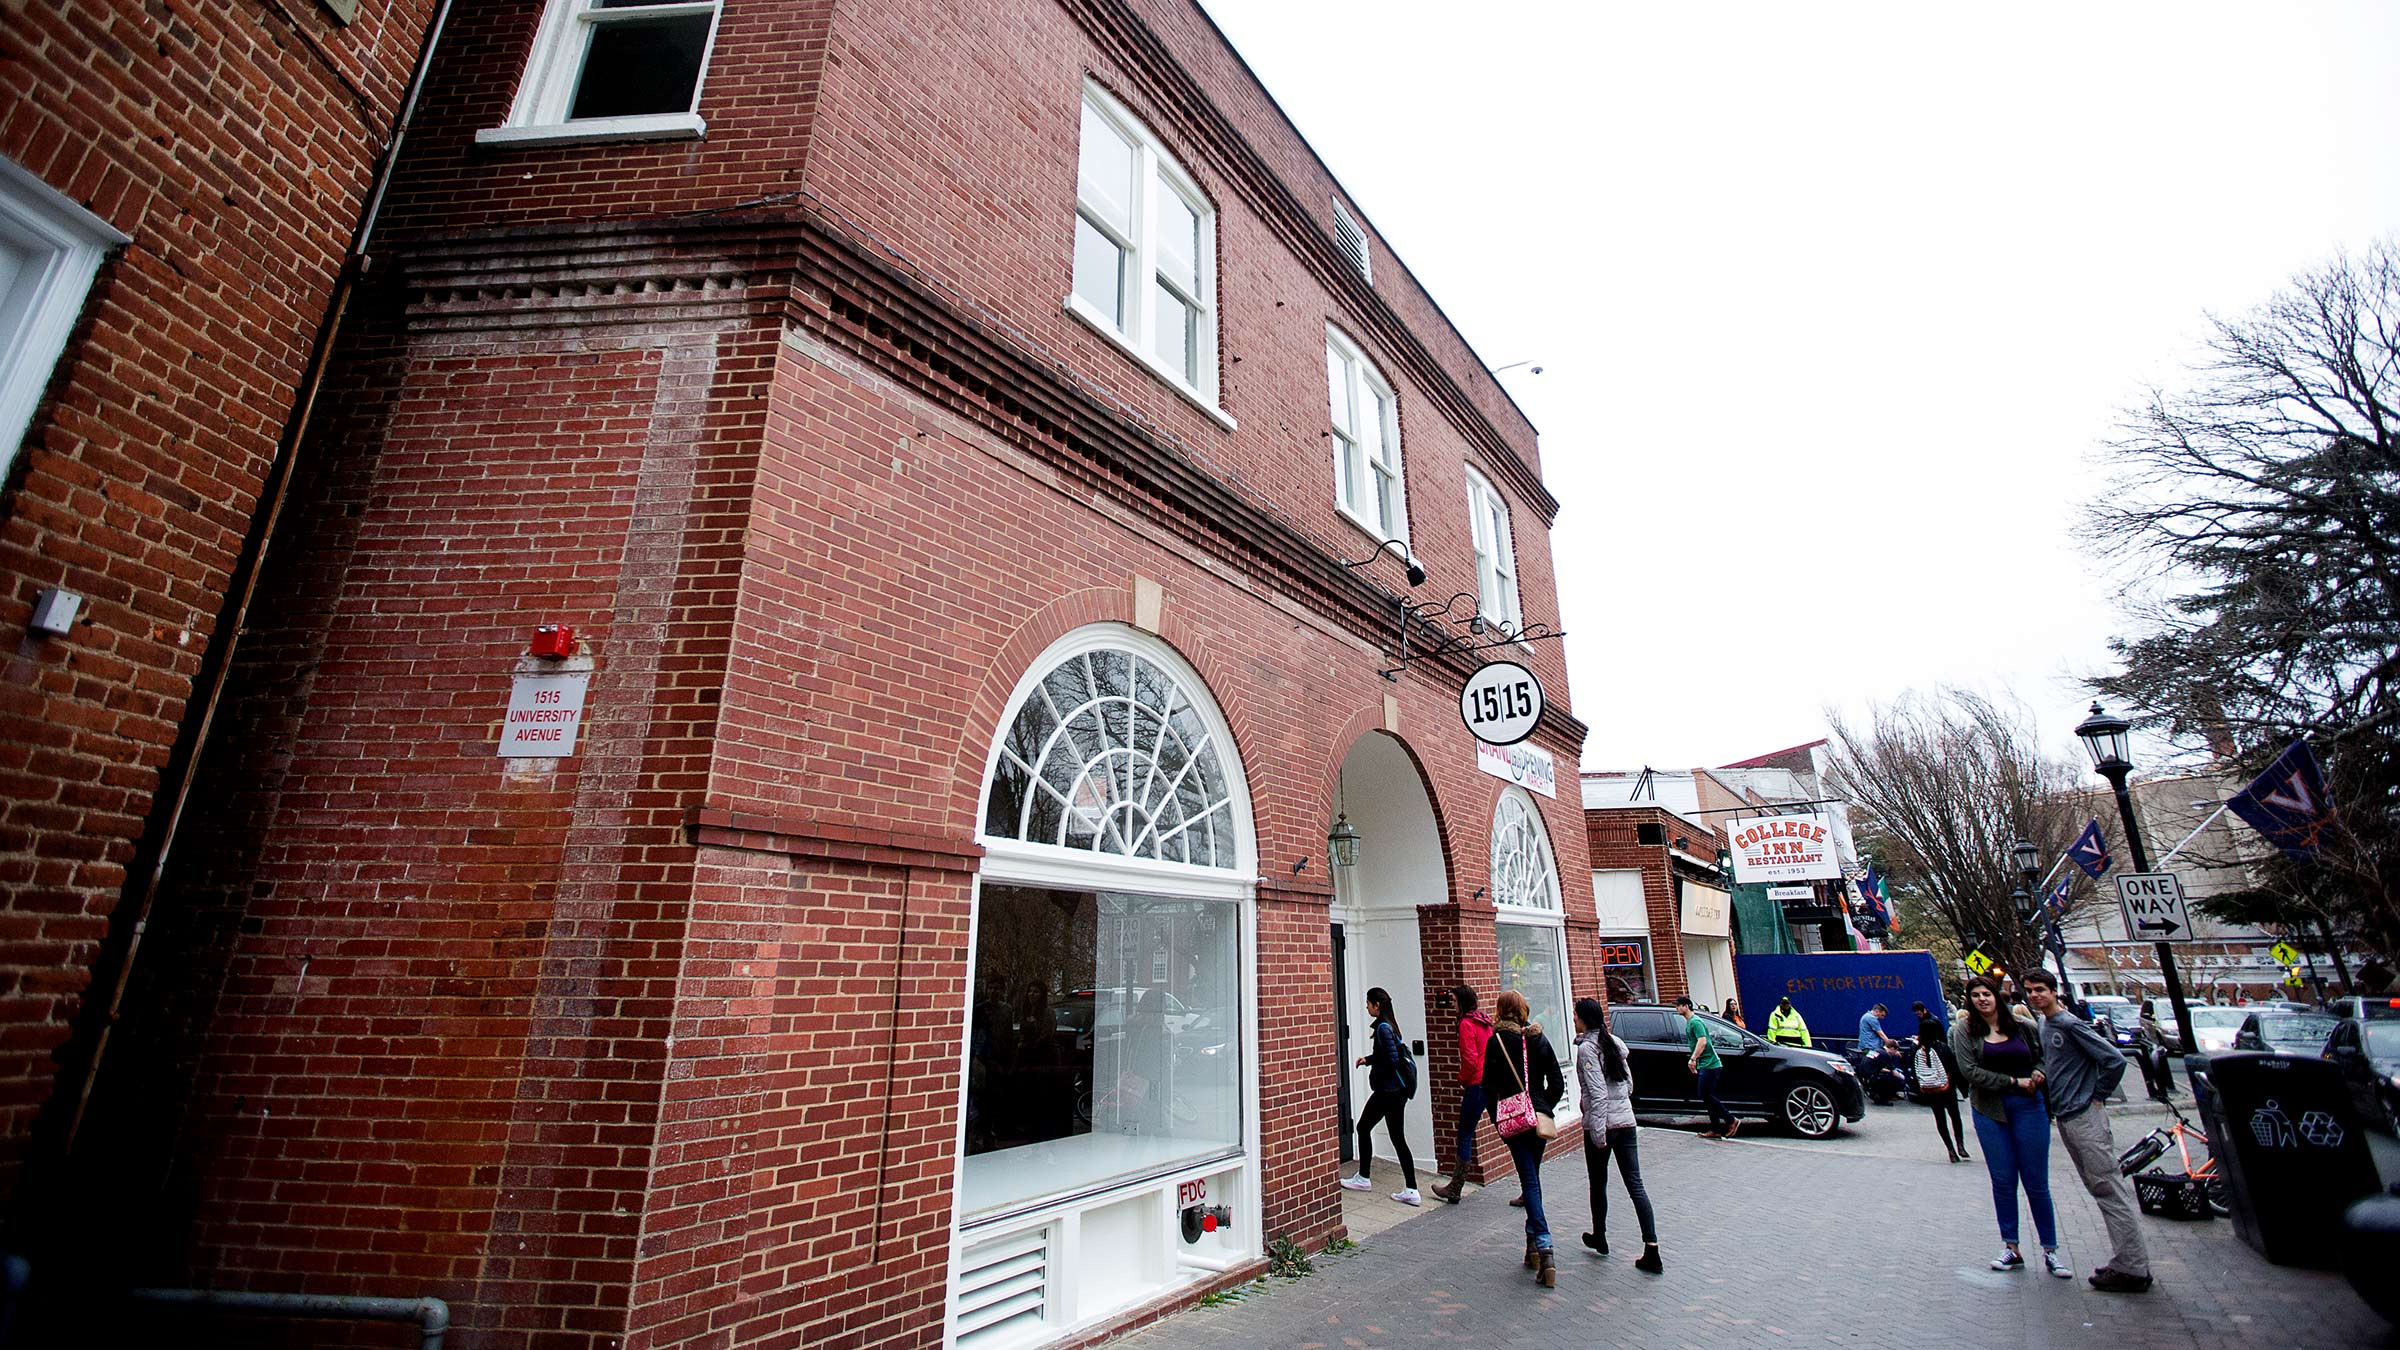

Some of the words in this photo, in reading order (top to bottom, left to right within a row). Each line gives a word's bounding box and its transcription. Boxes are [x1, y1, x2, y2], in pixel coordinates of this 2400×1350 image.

[534, 691, 561, 704] 1515
[510, 710, 577, 723] UNIVERSITY
[515, 729, 562, 742] AVENUE
[1735, 821, 1827, 849] COLLEGE
[1762, 841, 1803, 856] INN
[1747, 853, 1822, 867] RESTAURANT
[1787, 867, 1806, 875] 1953
[2126, 879, 2172, 896] ONE
[2129, 898, 2176, 915] WAY
[1786, 978, 1816, 993] EAT
[1822, 976, 1857, 991] MOR
[1180, 1178, 1206, 1205] FDC
